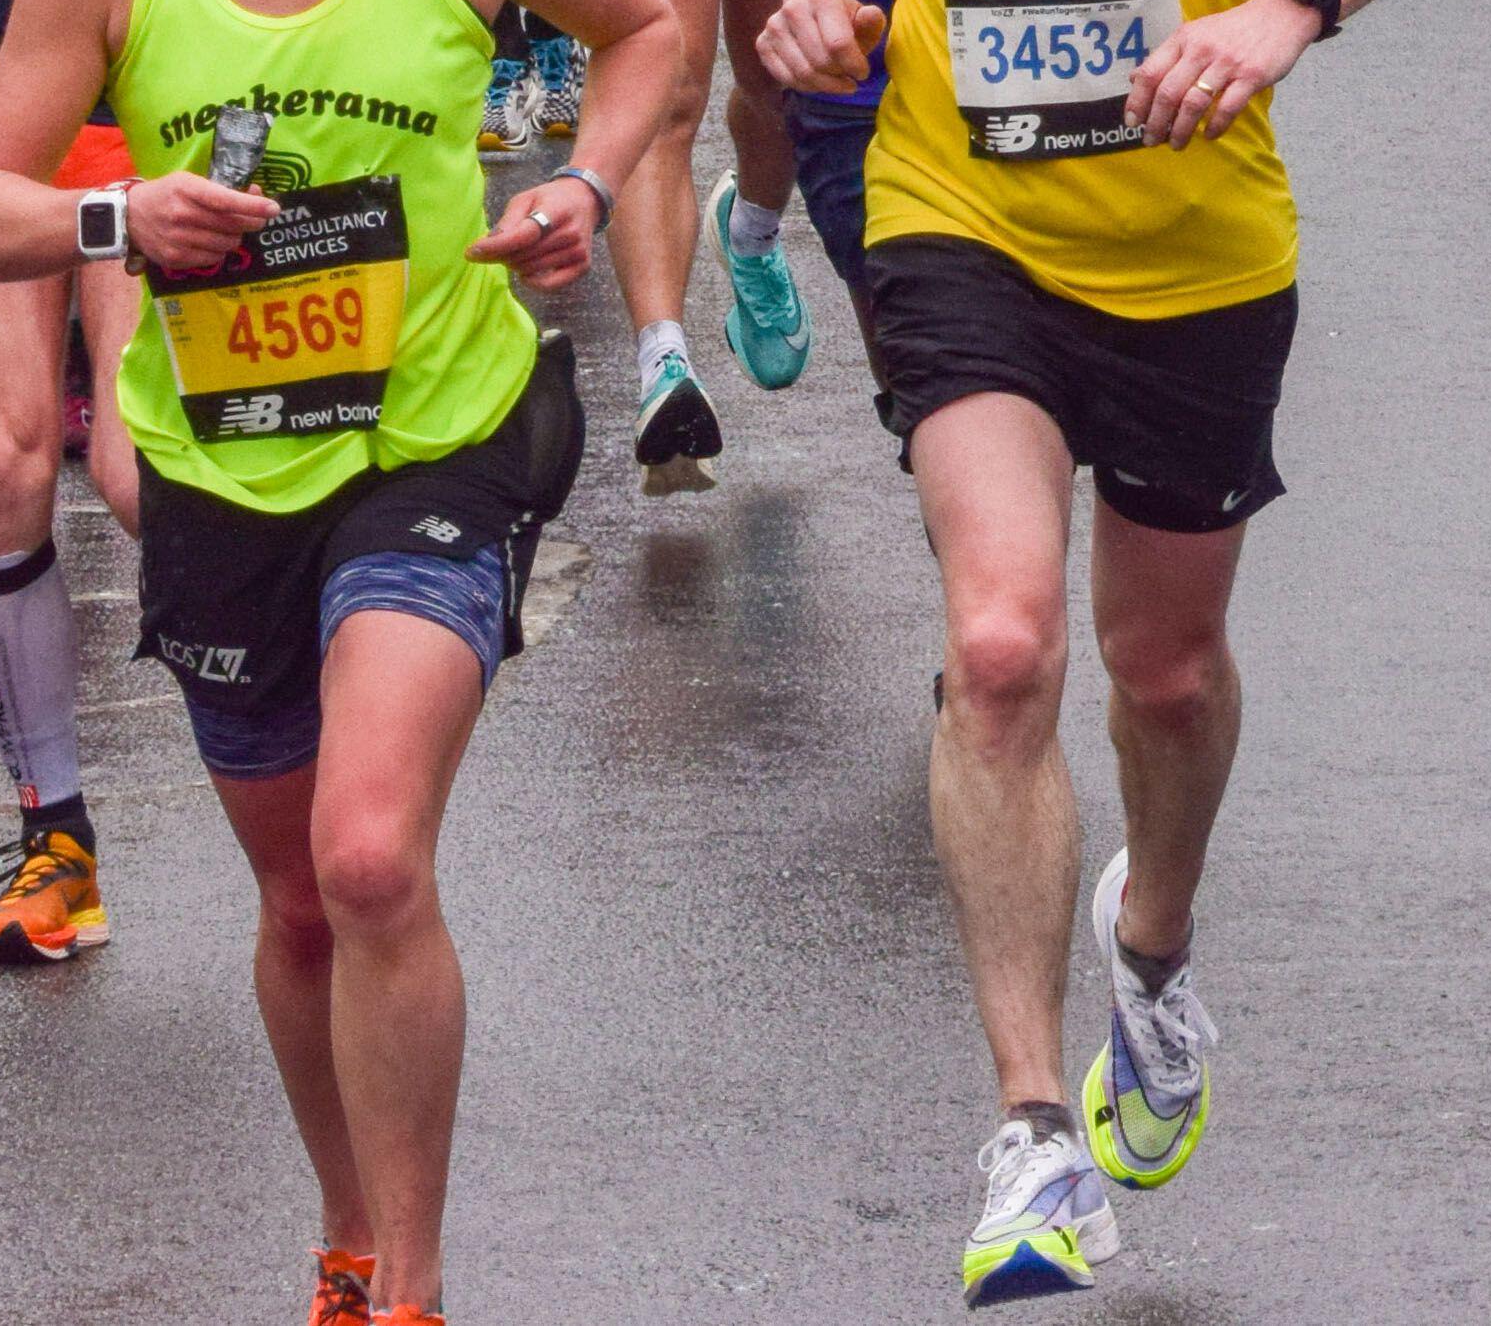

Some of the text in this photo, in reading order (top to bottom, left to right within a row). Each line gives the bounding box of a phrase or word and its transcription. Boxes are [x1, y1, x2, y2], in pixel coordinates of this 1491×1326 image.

[978, 16, 1150, 84] 34534
[1044, 135, 1089, 149] new
[259, 210, 387, 247] CONSULTANCY
[263, 236, 349, 267] SERVICES
[227, 287, 363, 364] 4569
[290, 406, 333, 430] new
